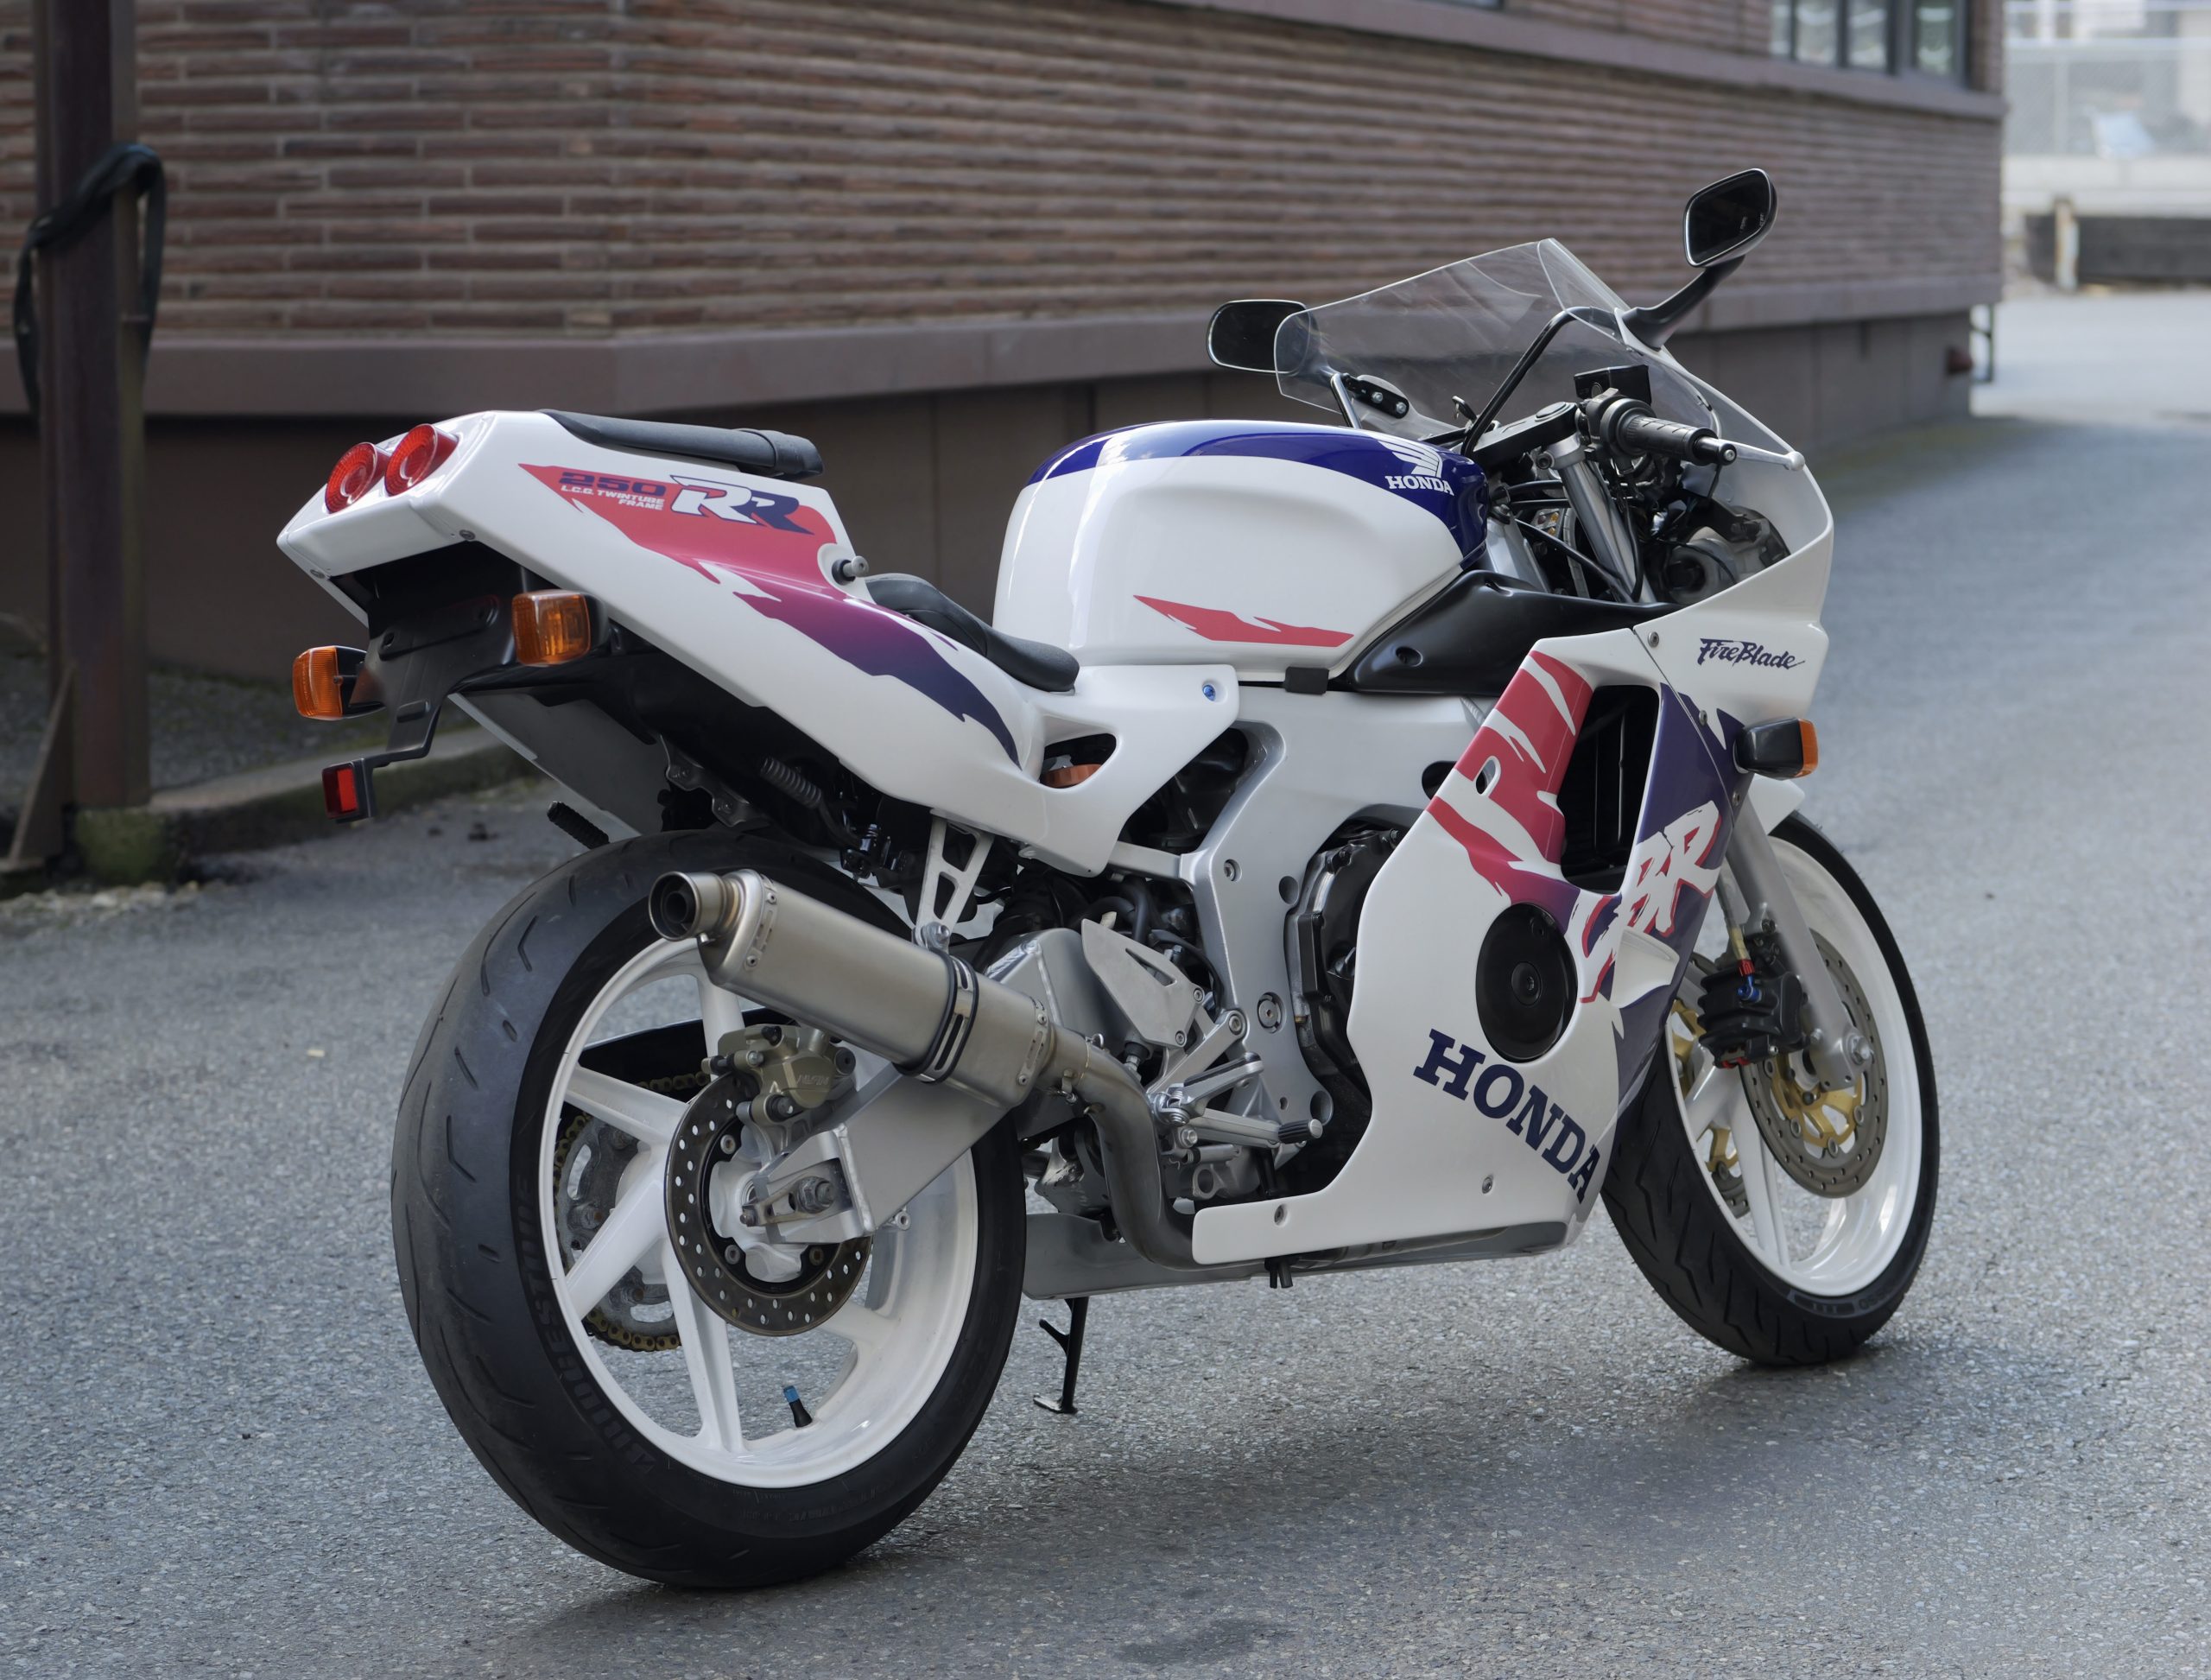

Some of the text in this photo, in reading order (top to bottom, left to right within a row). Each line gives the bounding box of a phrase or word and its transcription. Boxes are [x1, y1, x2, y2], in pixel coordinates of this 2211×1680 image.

[597, 490, 664, 504] TWINTUBE
[1384, 476, 1454, 497] HONDA
[559, 472, 815, 536] 250 RR
[618, 498, 663, 511] FRAME
[1697, 637, 1806, 669] FireBlade
[1413, 1028, 1600, 1204] HONDA
